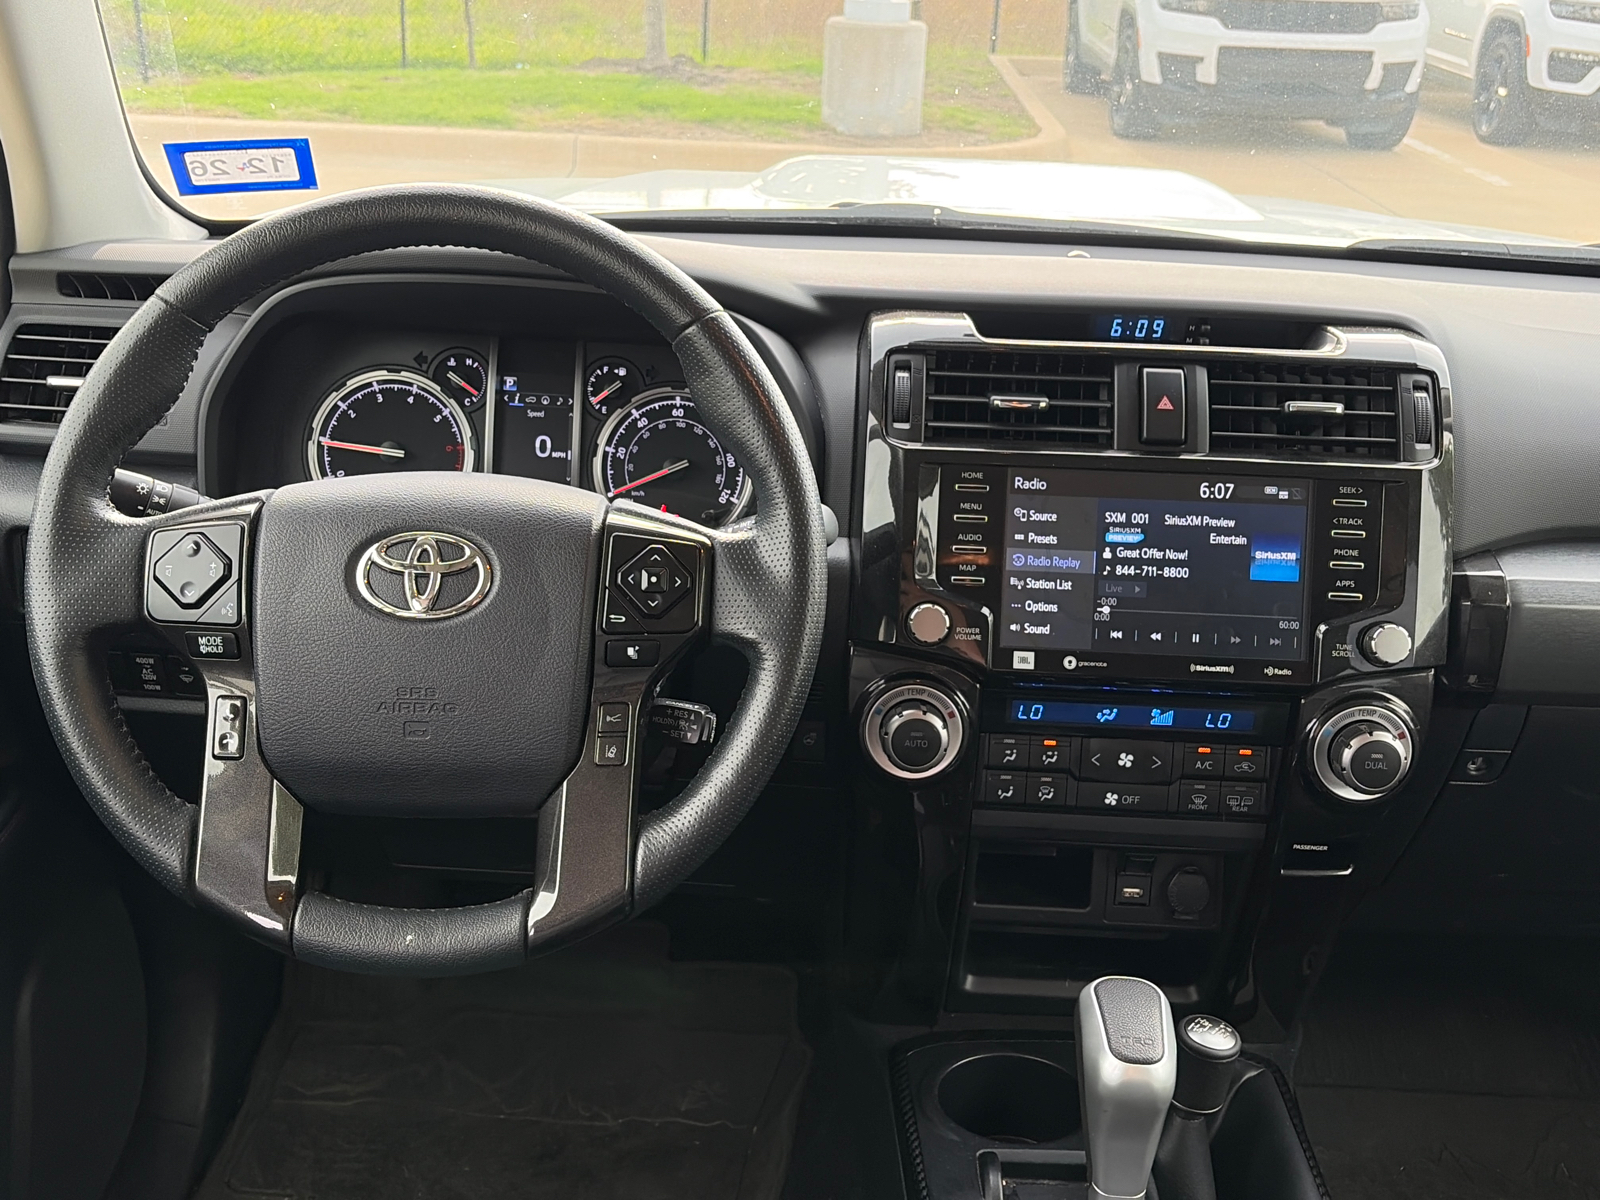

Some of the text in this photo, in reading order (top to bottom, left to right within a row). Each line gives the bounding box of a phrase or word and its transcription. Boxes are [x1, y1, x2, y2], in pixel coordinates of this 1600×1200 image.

[1110, 318, 1164, 338] 6:09
[466, 358, 473, 366] H
[602, 366, 609, 374] F
[376, 394, 384, 403] 3
[406, 396, 414, 404] 4
[464, 398, 470, 406] C
[347, 410, 356, 418] 2
[526, 409, 545, 418] Speed
[602, 406, 608, 414] E
[671, 408, 684, 417] 60
[434, 414, 442, 424] 5
[636, 418, 649, 429] 40
[534, 434, 566, 459] 0 MPH
[616, 446, 626, 460] 20
[961, 471, 984, 480] HOME
[1014, 477, 1047, 490] Radio
[1200, 482, 1234, 500] 6:07
[1339, 486, 1357, 494] SEEK
[718, 488, 732, 504] 120
[960, 502, 982, 510] MENU
[1029, 510, 1058, 522] Source
[1104, 512, 1236, 528] SXM 001 SiriusXM Preview
[1339, 518, 1363, 526] TRACK
[957, 533, 982, 542] AUDIO
[1028, 532, 1058, 545] Presets
[1210, 534, 1248, 546] Entertain
[1116, 547, 1188, 560] Great Offer Now!
[1255, 550, 1296, 560] SiriusXM
[1027, 555, 1080, 570] Radio Replay
[959, 564, 976, 572] MAP
[1115, 565, 1190, 578] 844-711-8800
[1026, 578, 1072, 591] Station List
[1106, 584, 1123, 593] Live
[1336, 580, 1355, 588] APPS
[1025, 602, 1058, 614] Options
[1094, 612, 1110, 622] 0:00
[1024, 623, 1050, 634] Sound
[1278, 620, 1300, 630] 60:00
[198, 636, 224, 646] MODE
[205, 646, 224, 654] HOLD
[1331, 650, 1355, 658] SCROLL
[1017, 656, 1031, 665] JBL
[1078, 660, 1108, 668] gracenote
[1274, 668, 1292, 676] Radio
[906, 688, 926, 697] TEMP
[674, 710, 689, 718] RES
[1358, 709, 1377, 718] TEMP
[670, 730, 685, 738] SET
[904, 740, 928, 748] AUTO
[1195, 760, 1214, 770] A/C
[1364, 761, 1388, 770] DUAL
[1122, 795, 1140, 805] OFF
[1292, 844, 1328, 852] PASSENGER
